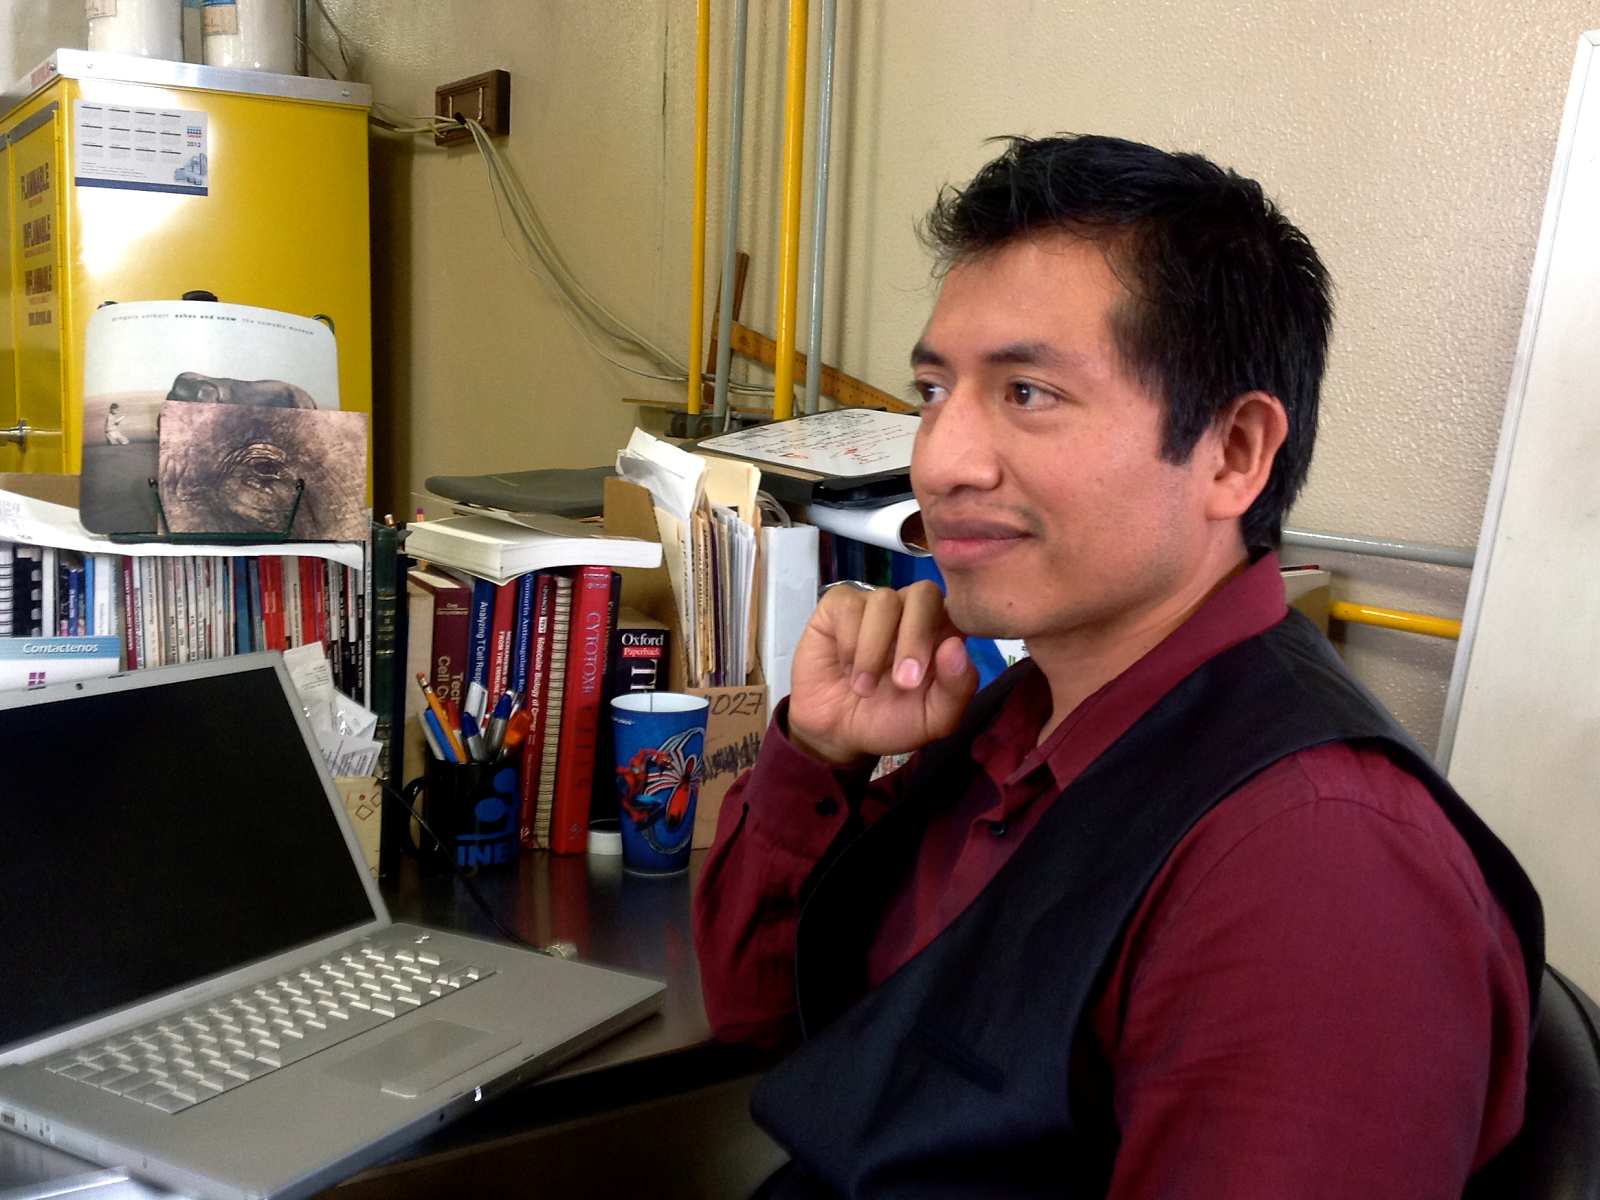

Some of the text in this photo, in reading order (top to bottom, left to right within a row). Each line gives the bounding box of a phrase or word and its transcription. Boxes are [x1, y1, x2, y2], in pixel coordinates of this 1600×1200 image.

[522, 573, 532, 616] Coumarin
[540, 584, 549, 616] ADVANCED
[475, 601, 489, 638] Analyzing
[22, 643, 99, 654] Contáctenos
[497, 630, 505, 651] FROM
[502, 630, 512, 673] MECHANISMS
[518, 617, 530, 676] Anticoagulant
[621, 632, 664, 646] Oxford
[623, 647, 660, 657] Paperback
[475, 645, 485, 661] Cell
[495, 651, 503, 665] THE
[534, 636, 545, 671] Molecular
[437, 655, 451, 682] Cell
[493, 665, 502, 694] IMMUNE
[531, 672, 542, 698] Biology
[531, 698, 539, 706] of
